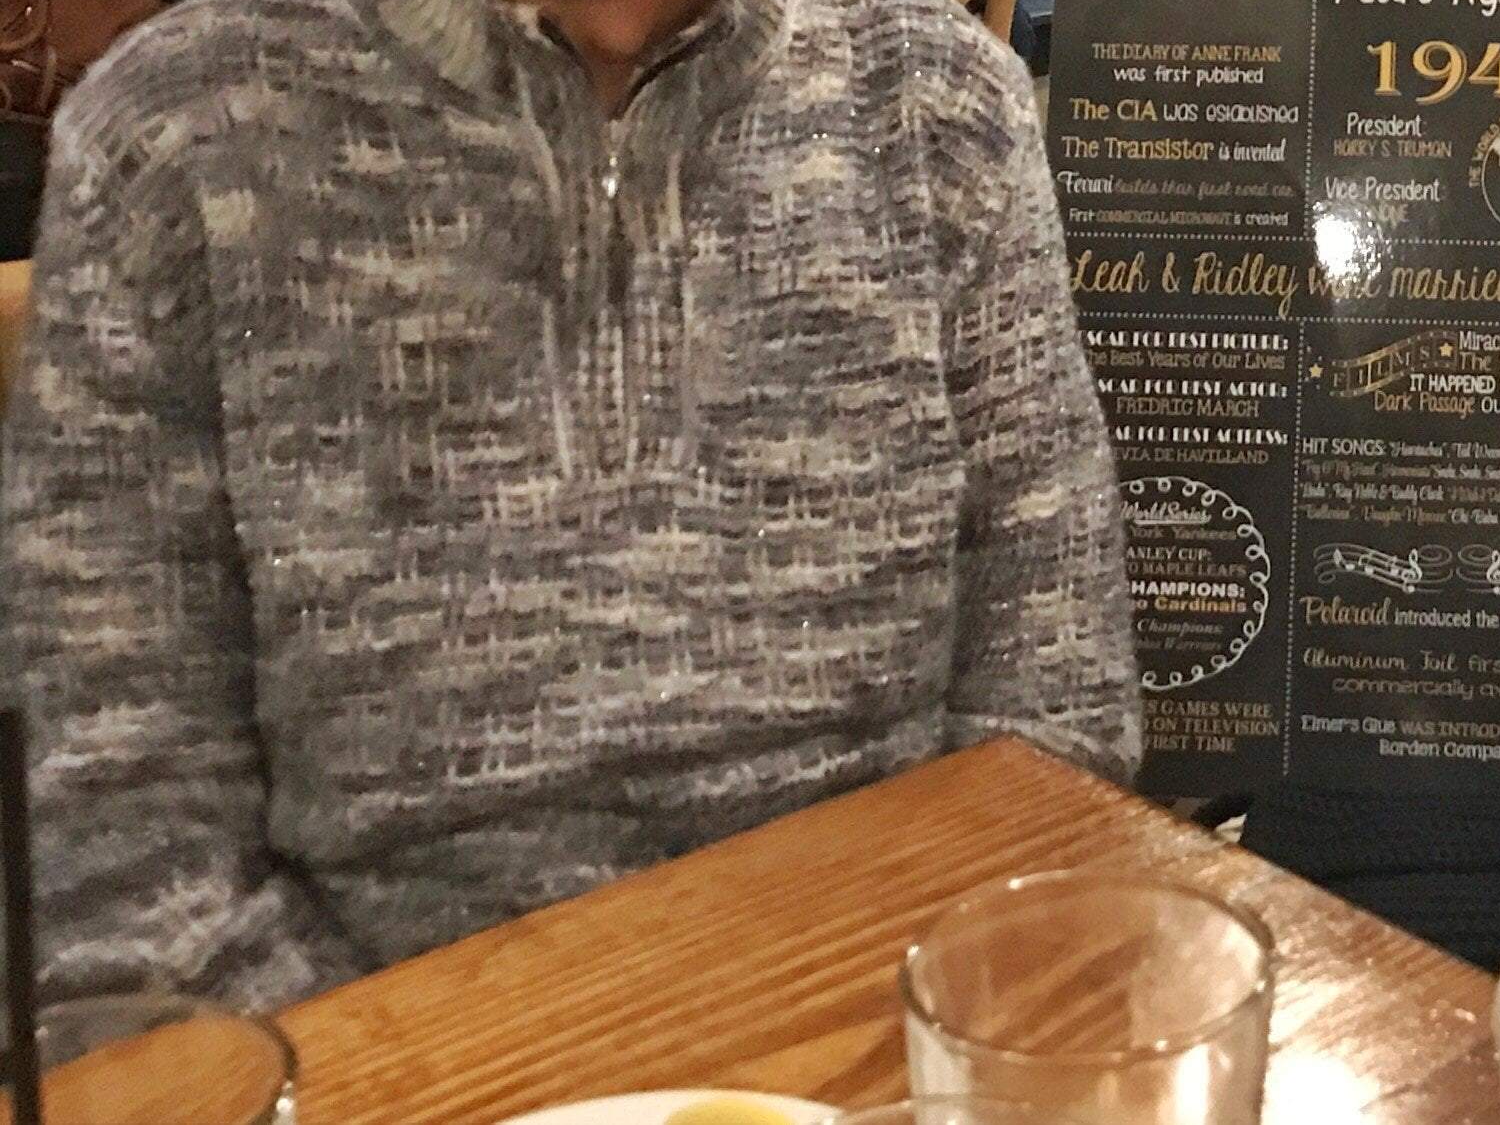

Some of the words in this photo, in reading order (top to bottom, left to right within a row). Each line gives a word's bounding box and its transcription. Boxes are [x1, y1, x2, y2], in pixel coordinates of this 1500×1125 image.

[1092, 43, 1121, 60] THE
[1123, 43, 1168, 61] DIARY
[1172, 43, 1191, 61] OF
[1192, 44, 1234, 63] ANNE
[1234, 45, 1283, 63] FRANK
[1113, 67, 1147, 82] was
[1154, 64, 1191, 83] first
[1196, 65, 1265, 87] published
[1069, 97, 1111, 120] The
[1116, 99, 1159, 122] CIA
[1163, 103, 1199, 123] was
[1061, 135, 1100, 159] The
[1104, 136, 1215, 162] Transistor
[1218, 141, 1231, 162] is
[1233, 138, 1287, 162] invented
[1324, 176, 1358, 200] Vice
[1070, 248, 1150, 294] Leah
[1161, 252, 1181, 294] &
[1190, 251, 1300, 320] Ridley
[1110, 350, 1145, 367] Best
[1212, 353, 1241, 369] Our
[1244, 353, 1285, 370] Lives
[1459, 350, 1491, 372] The
[1409, 373, 1425, 393] IT
[1428, 374, 1496, 394] HAPPENED
[1374, 390, 1412, 412] Dark
[1418, 391, 1475, 419] Passage
[1302, 437, 1328, 455] HIT
[1130, 579, 1247, 598] HAMPIONS:
[1154, 596, 1248, 613] Cardinals
[1394, 607, 1472, 629] introduced
[1475, 609, 1500, 628] the
[1332, 678, 1474, 703] commercially
[1183, 718, 1281, 736] TELEVISION
[1195, 735, 1237, 753] TIME
[1378, 738, 1441, 758] Borden
